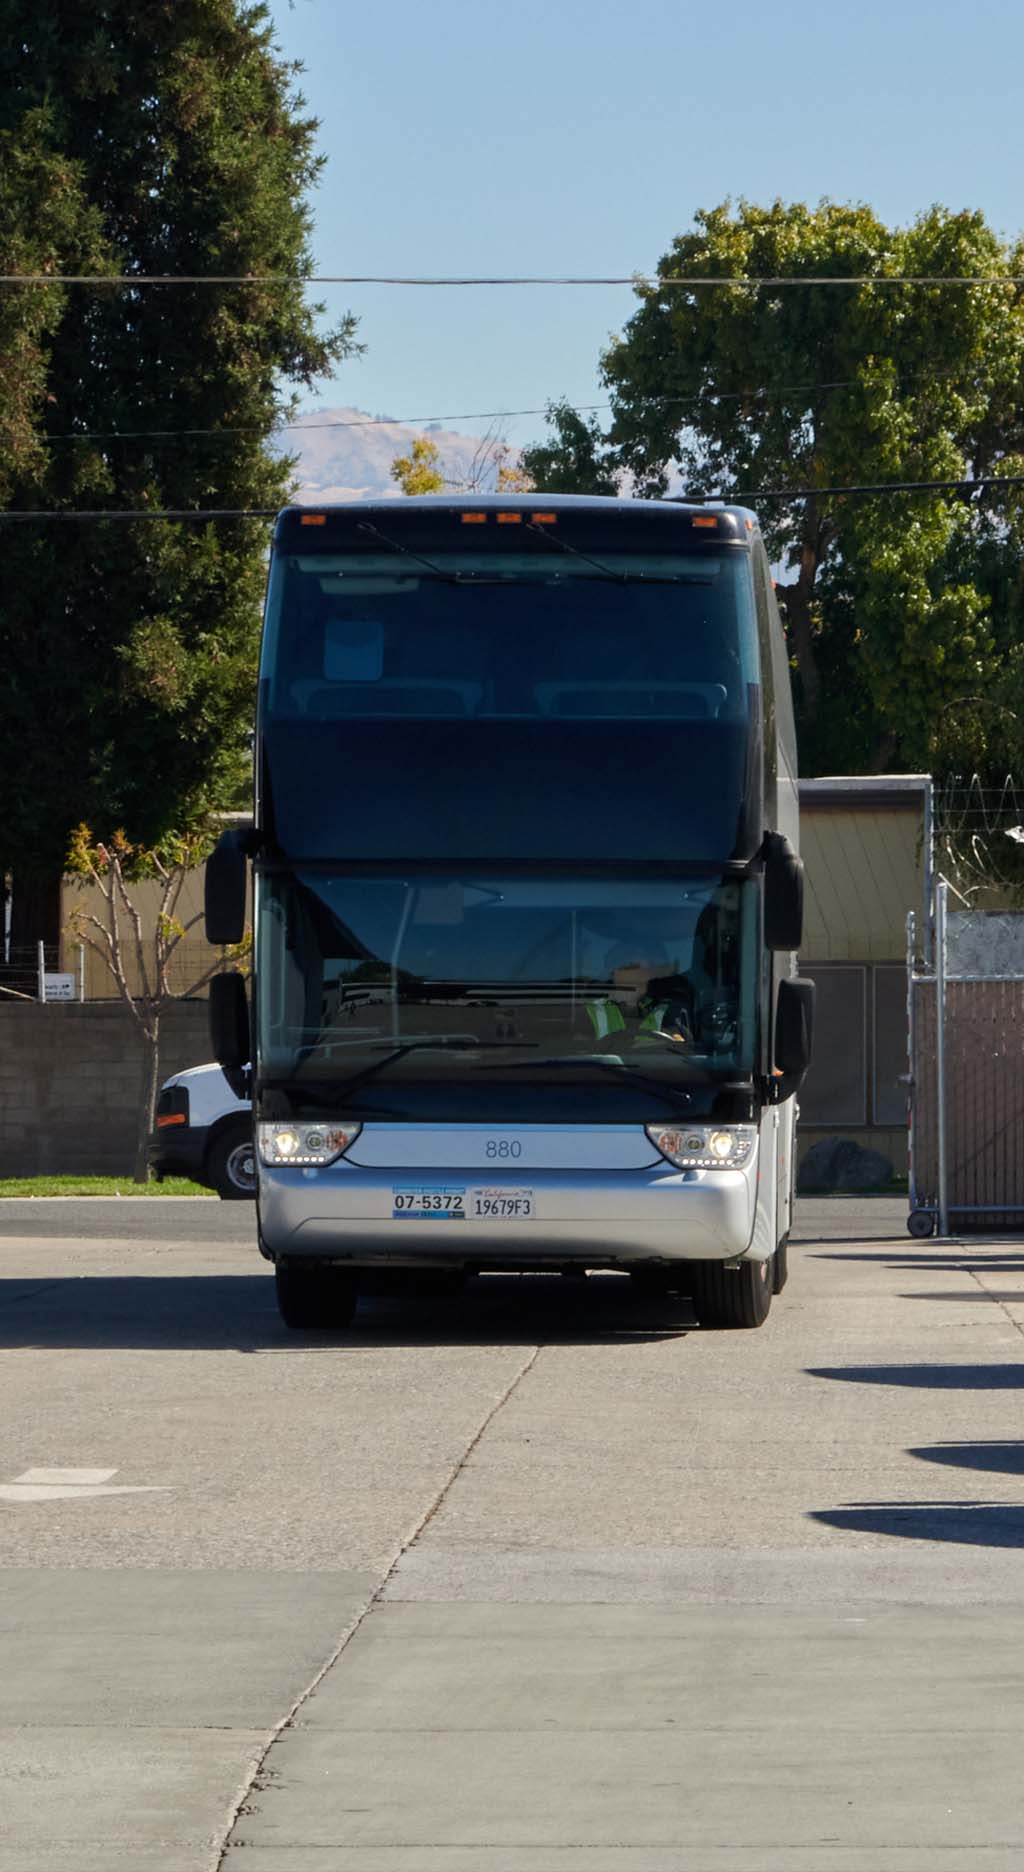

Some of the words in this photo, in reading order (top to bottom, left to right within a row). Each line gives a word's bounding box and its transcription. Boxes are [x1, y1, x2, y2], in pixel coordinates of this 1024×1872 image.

[486, 1140, 521, 1158] 880
[395, 1195, 463, 1210] 07-5372
[475, 1199, 531, 1215] 19679F3
